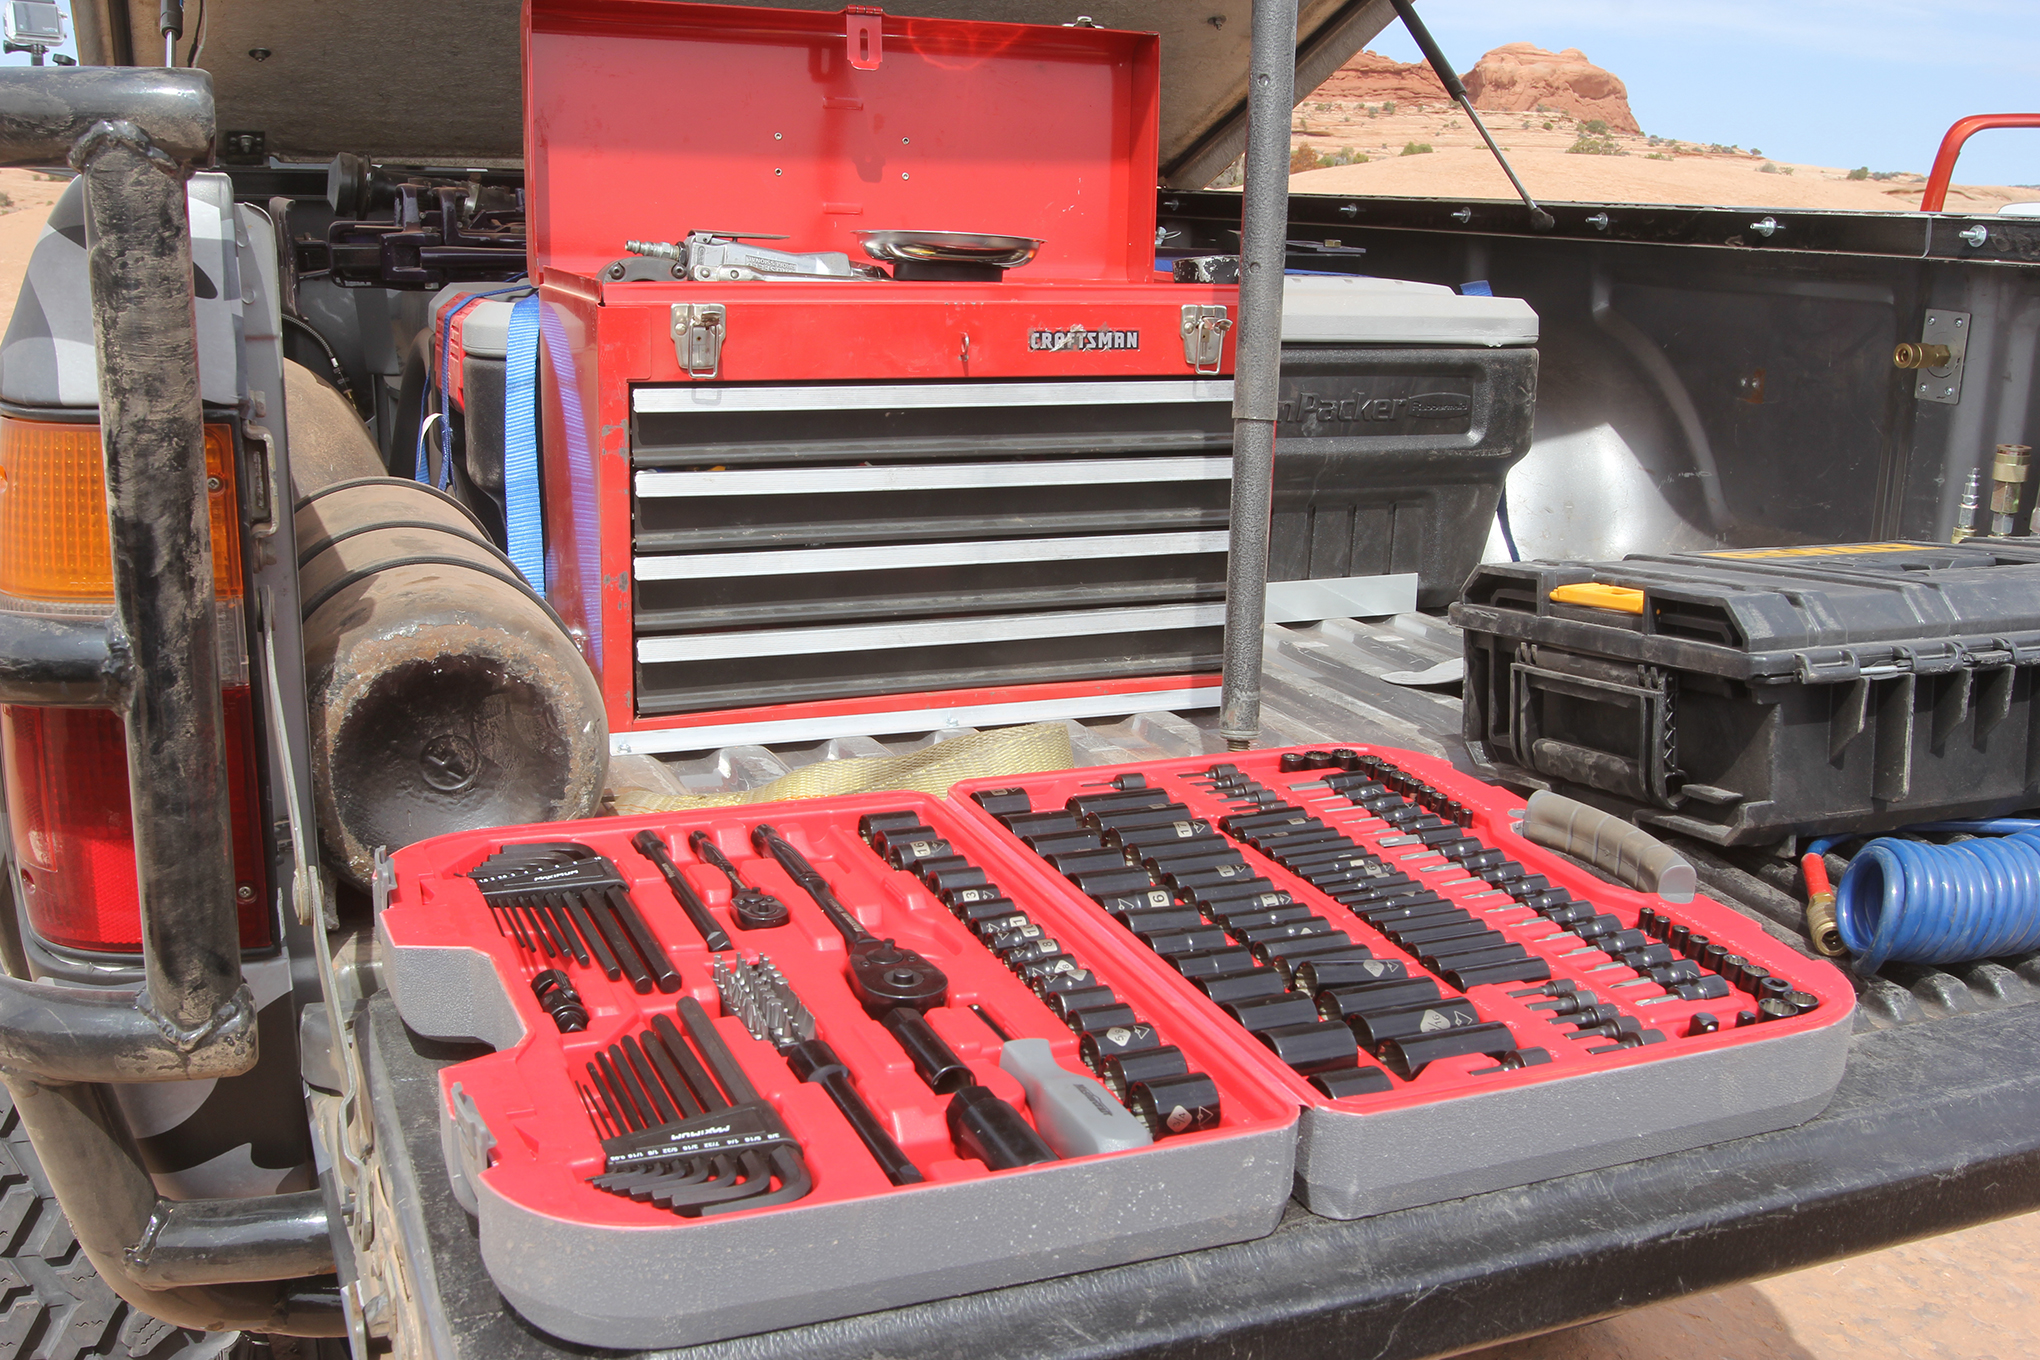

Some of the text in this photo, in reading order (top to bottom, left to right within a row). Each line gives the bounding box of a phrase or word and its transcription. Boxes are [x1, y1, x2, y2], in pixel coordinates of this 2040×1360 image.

[1030, 331, 1139, 349] CRAFTSMAN
[1278, 391, 1405, 425] nPacker
[1412, 402, 1468, 412] Rubbermaid
[1178, 823, 1190, 836] 17
[913, 841, 928, 855] 16
[533, 869, 579, 882] MAXIMUM
[1112, 1026, 1127, 1043] 5/8
[1170, 1110, 1188, 1129] 3/4
[671, 1124, 731, 1141] MAXIMUM
